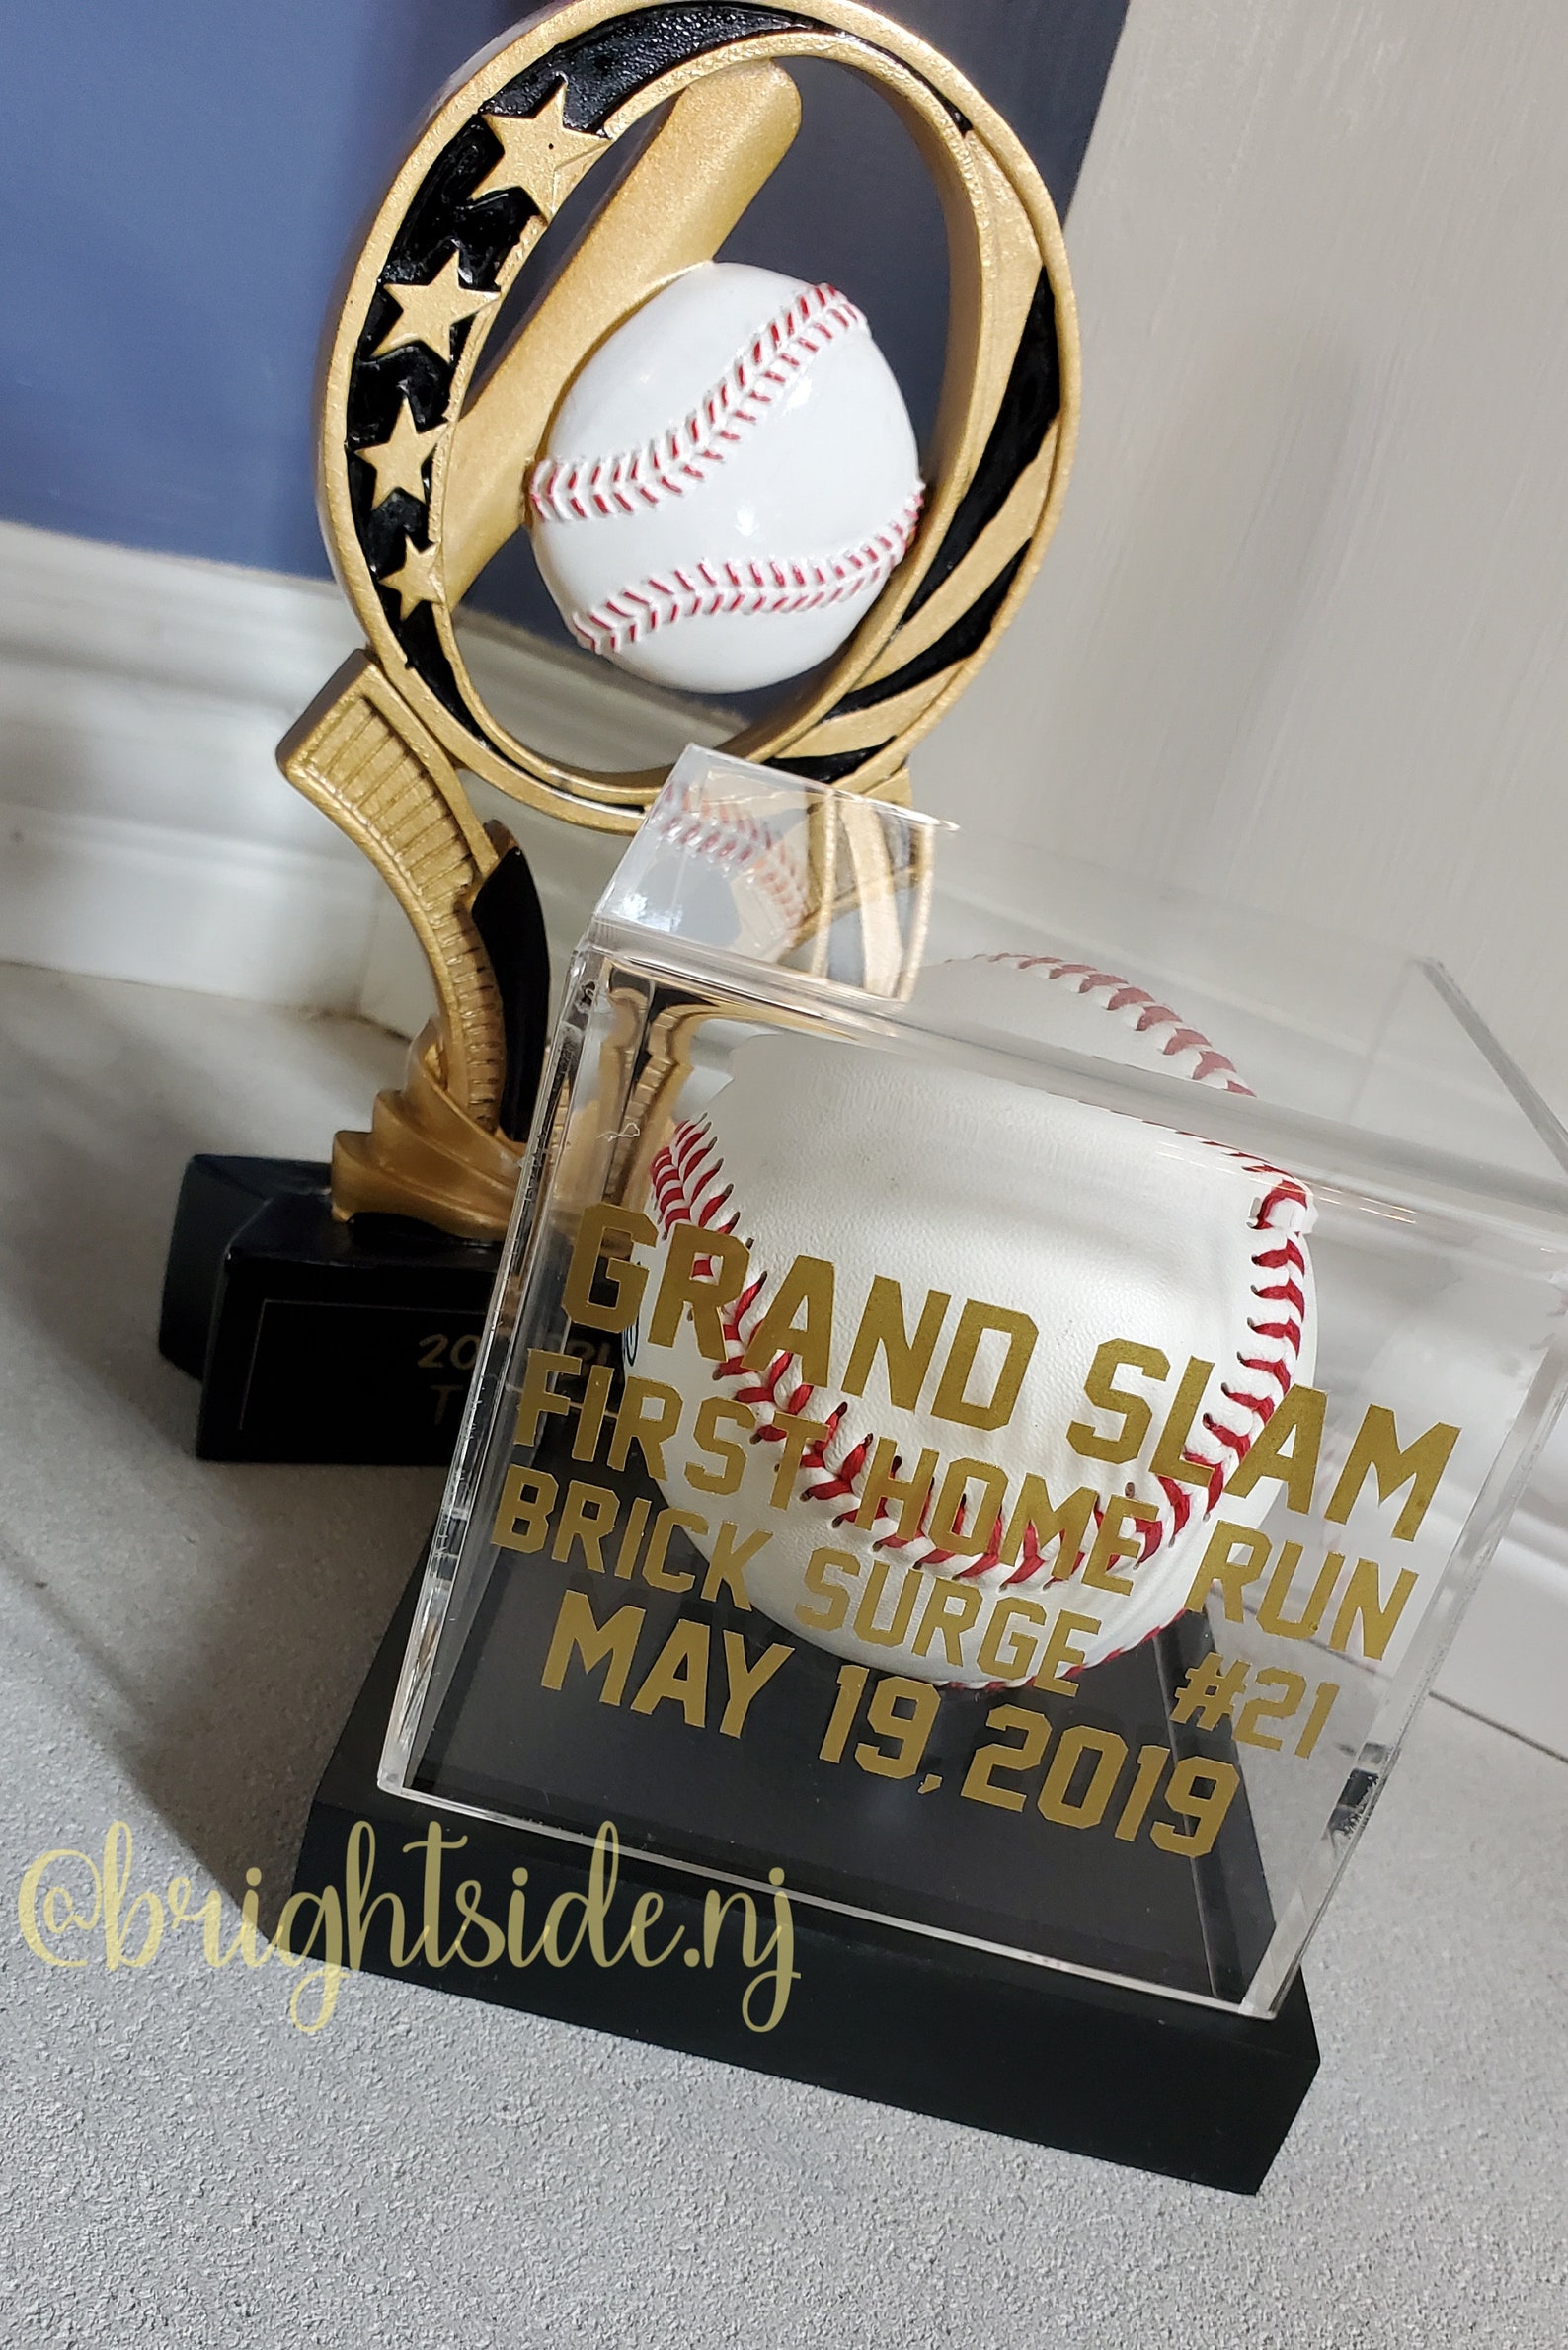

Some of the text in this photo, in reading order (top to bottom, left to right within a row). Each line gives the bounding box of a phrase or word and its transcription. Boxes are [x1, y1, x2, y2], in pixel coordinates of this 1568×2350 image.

[512, 1348, 1419, 1661] FIRST HOME RUN
[561, 1202, 1463, 1542] GRAND SLAM
[490, 1464, 1340, 1760] BRICK SURGE #21
[540, 1589, 796, 1740] MAY
